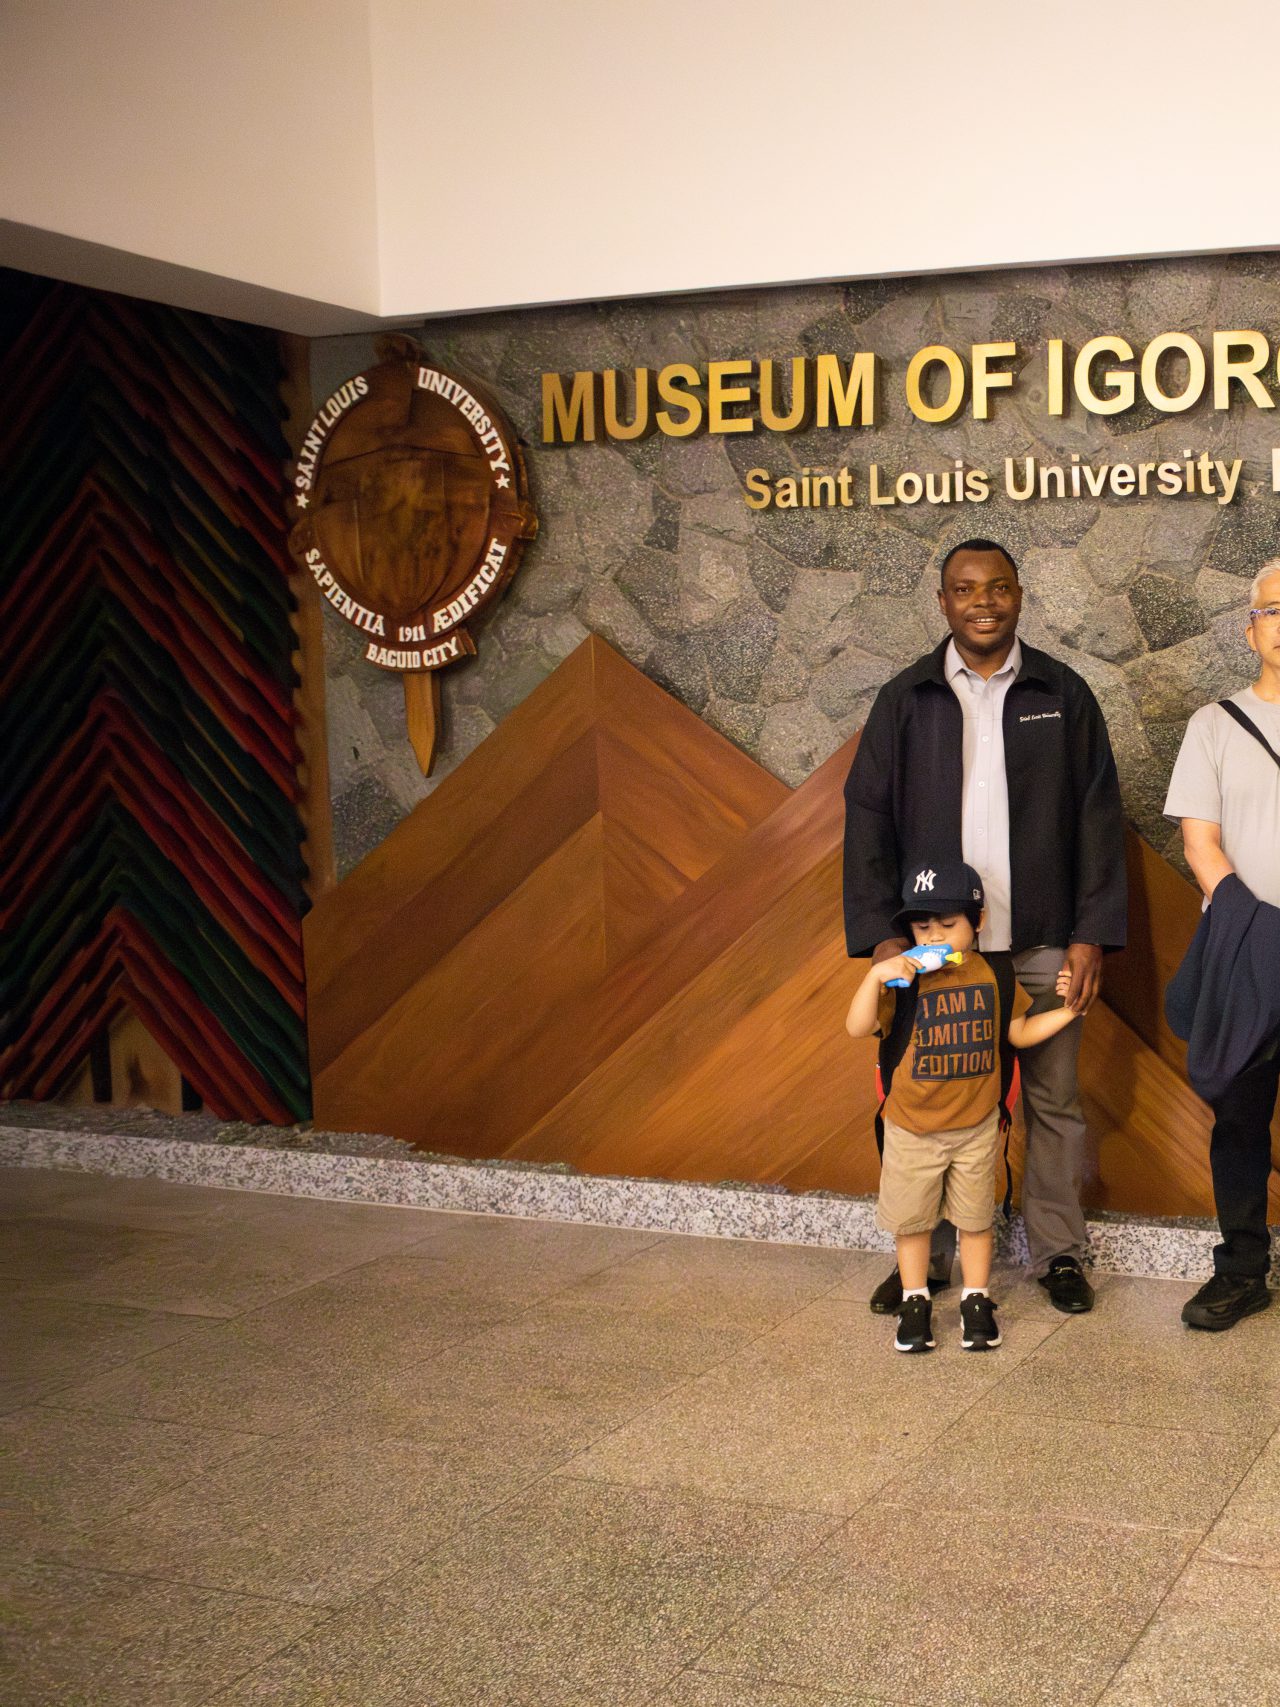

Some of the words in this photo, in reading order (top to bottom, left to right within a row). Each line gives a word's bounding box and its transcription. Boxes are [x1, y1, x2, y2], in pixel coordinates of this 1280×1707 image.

[541, 352, 876, 443] MUSEUM
[905, 341, 1018, 423] OF
[295, 419, 327, 490] SAINT
[323, 375, 370, 429] LOUIS
[417, 366, 510, 473] UNIVERSITY
[744, 466, 854, 511] Saint
[869, 459, 990, 506] Louis
[1004, 449, 1243, 505] University
[305, 547, 386, 637] SAPIENTIA
[433, 537, 508, 634] ÆDIFICAT
[398, 624, 427, 643] 1911
[365, 642, 421, 669] BAGUIO
[422, 636, 459, 667] CITY
[913, 869, 937, 893] NY
[922, 998, 930, 1019] I
[935, 991, 967, 1016] AM
[973, 989, 986, 1011] A
[915, 1019, 993, 1048] LIMITED
[917, 1049, 993, 1076] EDITION
